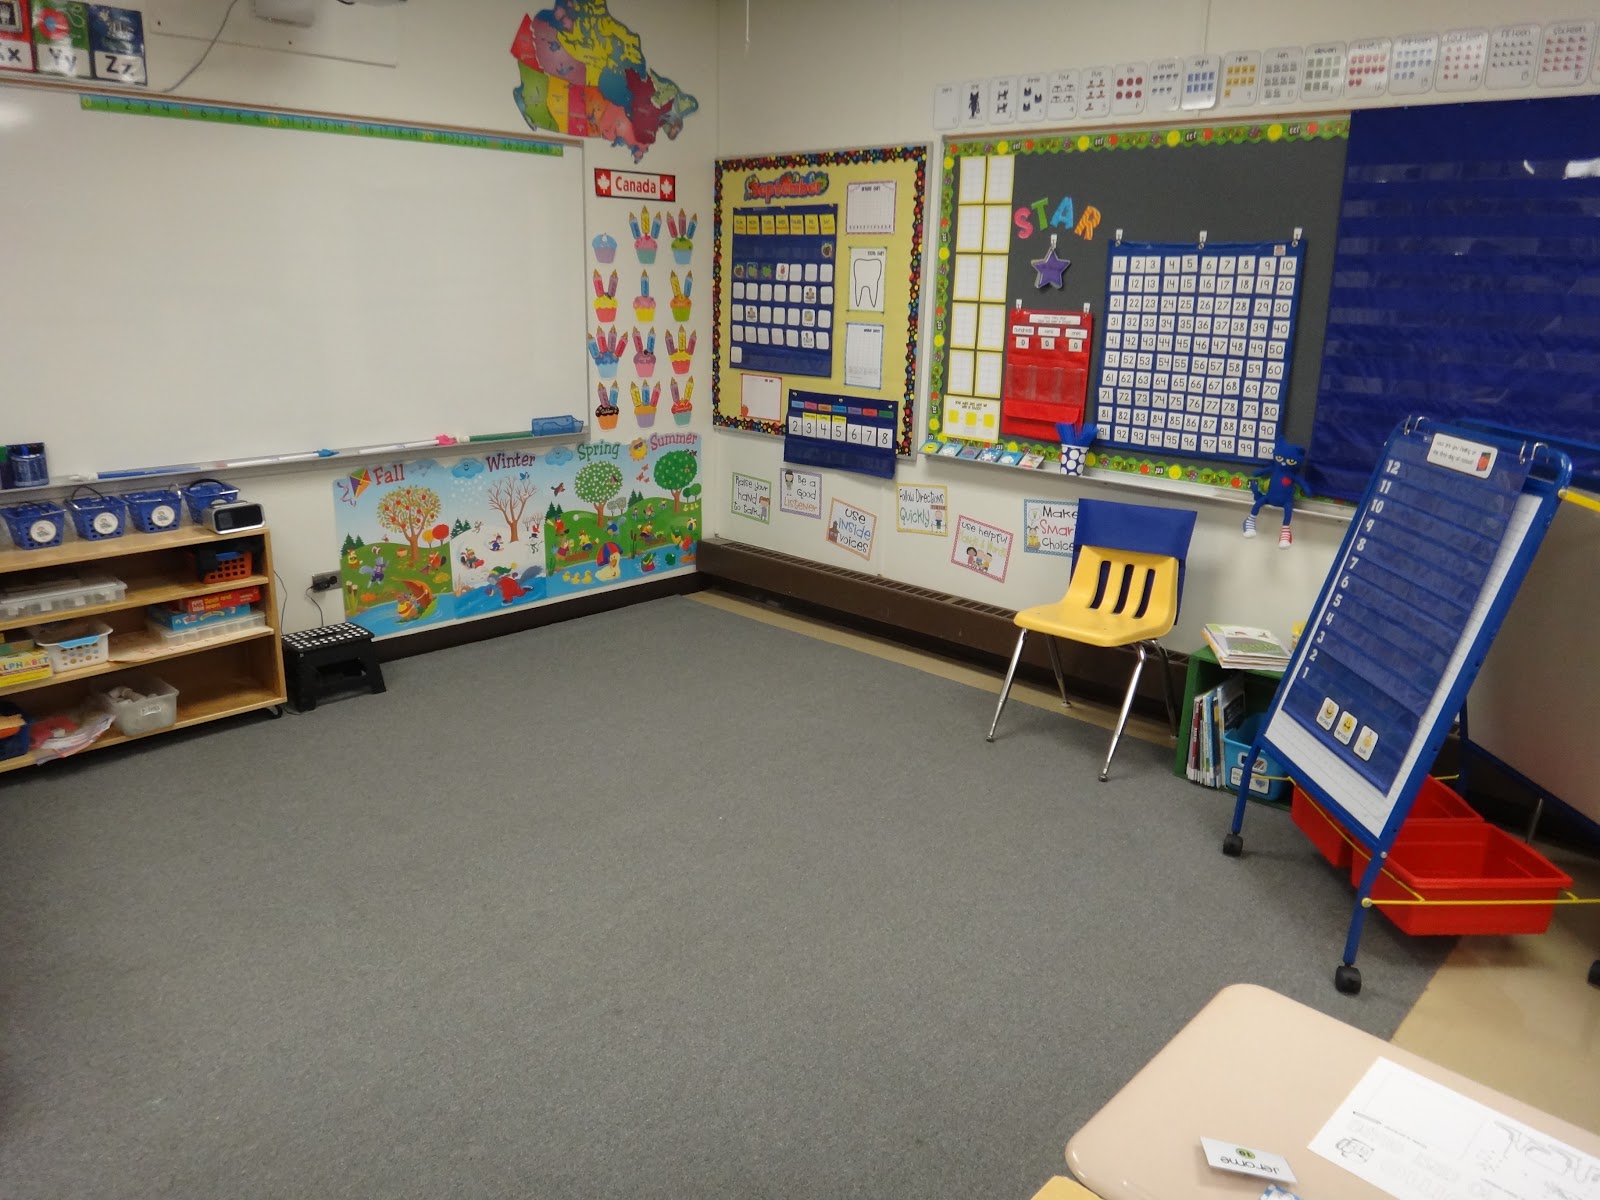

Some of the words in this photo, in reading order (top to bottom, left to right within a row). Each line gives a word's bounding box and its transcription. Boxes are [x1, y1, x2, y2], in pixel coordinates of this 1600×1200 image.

[615, 176, 656, 194] Canada
[750, 177, 822, 203] September
[1014, 196, 1101, 240] STAR
[1135, 260, 1141, 270] 2
[1150, 259, 1156, 270] 3
[1169, 260, 1175, 270] 4
[1187, 258, 1193, 269] 5
[1206, 260, 1212, 270] 6
[1224, 260, 1231, 270] 7
[1243, 259, 1250, 270] 8
[1264, 260, 1271, 271] 9
[1282, 260, 1294, 271] 10
[1114, 278, 1120, 287] 11
[1131, 279, 1140, 288] 12
[1147, 279, 1156, 289] 13
[1166, 279, 1175, 289] 14
[1183, 278, 1193, 289] 15
[1203, 279, 1212, 289] 16
[1220, 280, 1230, 290] 17
[1240, 279, 1250, 290] 18
[1260, 279, 1270, 290] 19
[1278, 280, 1292, 291] 20
[1113, 298, 1121, 308] 21
[1129, 298, 1140, 308] 22
[1144, 298, 1156, 309] 23
[1163, 299, 1174, 309] 24
[1180, 299, 1192, 310] 25
[1199, 300, 1211, 310] 26
[1216, 300, 1230, 311] 27
[1235, 301, 1247, 312] 28
[1256, 302, 1269, 312] 29
[1275, 302, 1289, 314] 30
[1110, 317, 1119, 326] 31
[1126, 317, 1138, 327] 32
[1143, 318, 1155, 328] 33
[1160, 318, 1172, 328] 34
[1180, 319, 1192, 330] 35
[1197, 320, 1209, 330] 36
[1215, 320, 1228, 331] 37
[1233, 322, 1245, 332] 38
[1252, 322, 1266, 333] 39
[1273, 324, 1288, 334] 40
[1108, 336, 1117, 345] 41
[1125, 336, 1136, 346] 42
[1142, 337, 1154, 347] 43
[1158, 338, 1170, 348] 44
[1176, 339, 1189, 349] 45
[1195, 340, 1207, 350] 46
[1213, 340, 1226, 350] 47
[1231, 342, 1243, 352] 48
[1250, 343, 1264, 354] 49
[1269, 344, 1284, 355] 50
[1108, 354, 1116, 364] 51
[1123, 355, 1134, 365] 52
[1139, 356, 1151, 366] 53
[1158, 357, 1170, 367] 54
[1174, 358, 1187, 369] 55
[1194, 360, 1205, 370] 56
[1210, 361, 1223, 371] 57
[1228, 362, 1240, 373] 58
[1248, 364, 1261, 374] 59
[1268, 365, 1282, 376] 60
[1105, 373, 1114, 382] 61
[1120, 374, 1132, 384] 62
[1137, 375, 1149, 385] 63
[1155, 376, 1166, 386] 64
[1173, 378, 1185, 388] 65
[1190, 379, 1202, 390] 66
[1208, 381, 1221, 390] 67
[1225, 381, 1238, 391] 68
[1245, 384, 1258, 394] 69
[1264, 384, 1278, 396] 70
[792, 420, 798, 432] 2
[806, 422, 812, 434] 3
[820, 423, 827, 435] 4
[835, 426, 842, 437] 5
[851, 428, 857, 440] 6
[866, 430, 872, 442] 7
[882, 432, 888, 445] 8
[650, 432, 698, 451] Summer
[576, 442, 620, 462] Spring
[486, 452, 536, 473] Winter
[1386, 459, 1400, 475] 12
[373, 464, 406, 486] Fall
[797, 475, 807, 485] Be
[735, 475, 752, 488] Raise
[754, 482, 768, 492] your
[1379, 479, 1392, 494] 11
[737, 488, 758, 506] hand
[796, 488, 816, 500] Good
[899, 488, 915, 503] Follow
[915, 488, 944, 504] Directions
[733, 502, 742, 511] to
[1042, 505, 1078, 519] Make
[1370, 499, 1384, 514] 10
[900, 506, 930, 528] Quickly
[1040, 519, 1074, 536] Smar
[1366, 519, 1375, 532] 9
[839, 532, 869, 553] voices
[978, 526, 1008, 544] helpful
[1042, 538, 1074, 551] Choice
[1357, 538, 1367, 551] 8
[1350, 557, 1359, 569] 7
[1341, 576, 1349, 588] 6
[1333, 594, 1343, 607] 5
[1326, 612, 1334, 625] 4
[1317, 631, 1326, 644] 3
[1309, 649, 1318, 661] 2
[1302, 666, 1310, 678] 1
[1220, 1156, 1279, 1174] Jerome
